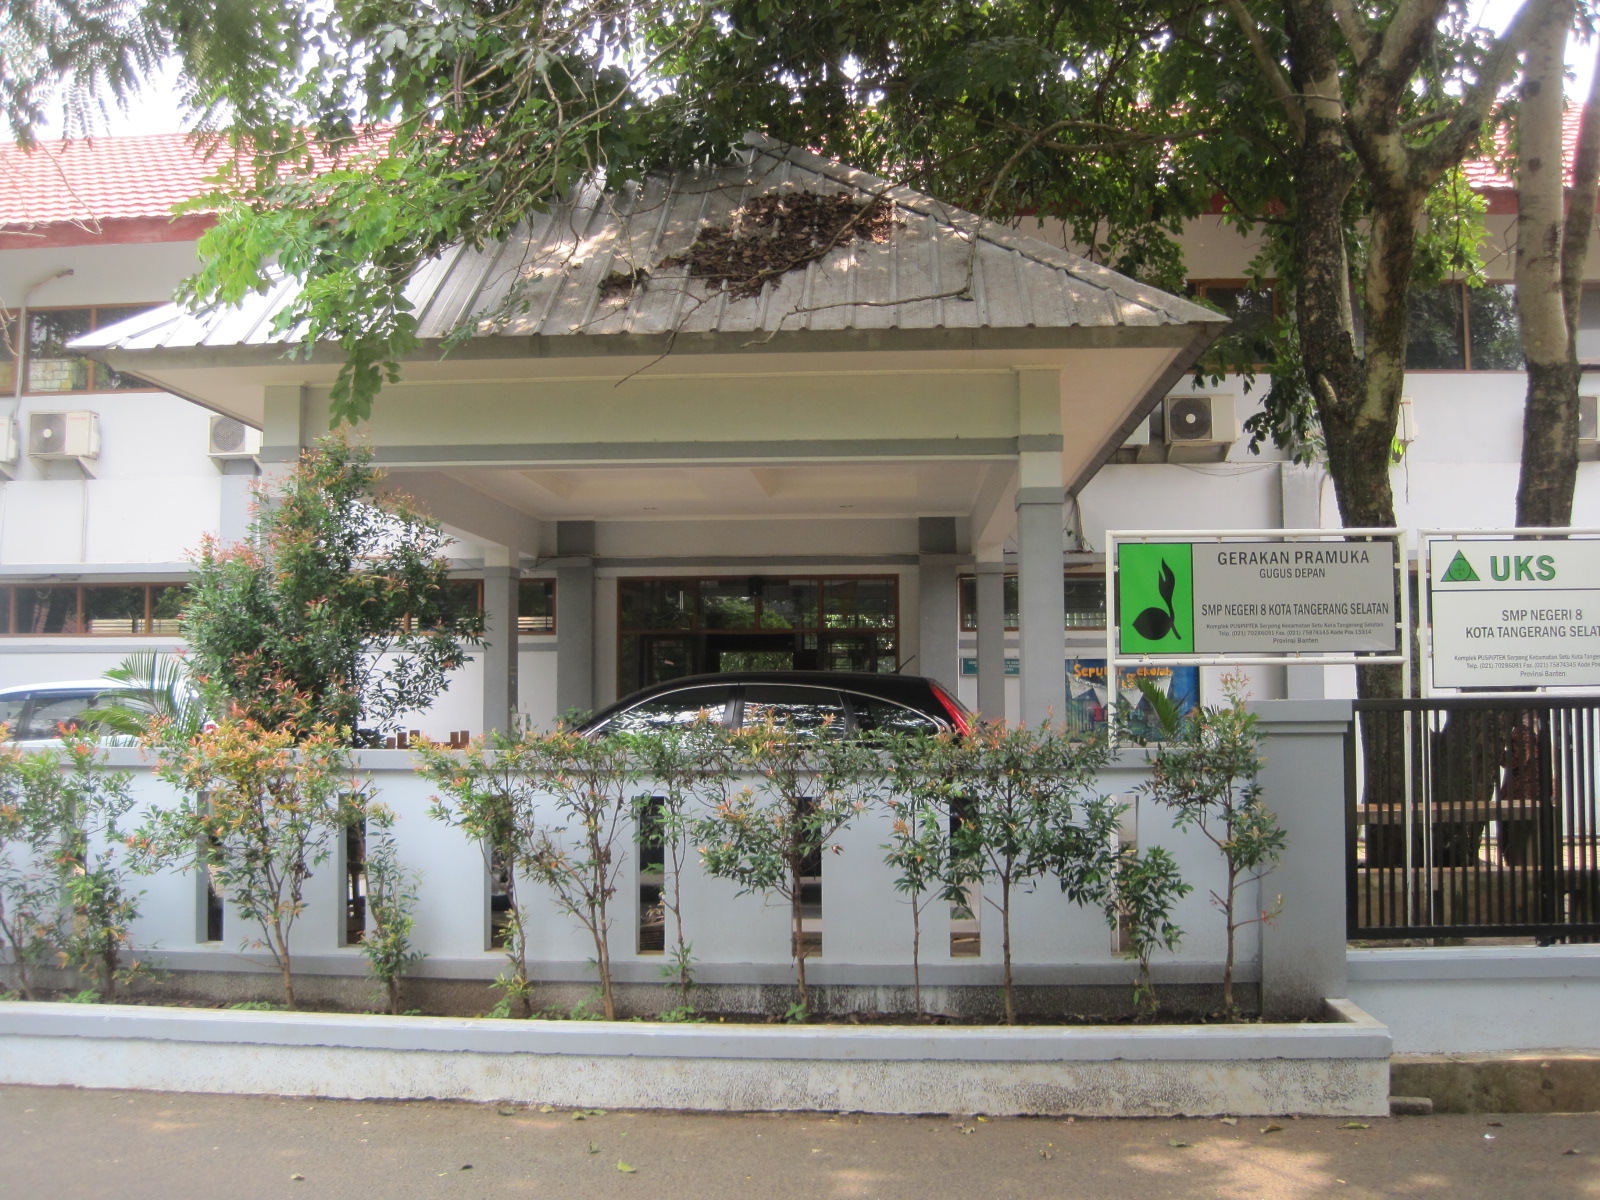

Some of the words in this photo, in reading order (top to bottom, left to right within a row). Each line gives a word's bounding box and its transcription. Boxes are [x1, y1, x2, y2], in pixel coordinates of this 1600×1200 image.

[1218, 551, 1290, 565] GERAKAN
[1294, 550, 1370, 564] PRAMUKA
[1259, 568, 1293, 579] GUGUS
[1295, 568, 1326, 578] DEPAN
[1490, 555, 1556, 582] UKS
[1201, 604, 1223, 616] SMP
[1225, 604, 1258, 616] NEGERI
[1260, 604, 1267, 616] 8
[1269, 604, 1292, 615] KOTA
[1293, 603, 1348, 615] TANGERANG
[1350, 602, 1389, 615] SELATAN
[1502, 609, 1527, 621] SMP
[1530, 609, 1572, 621] NEGERI
[1575, 608, 1583, 620] 8
[1465, 627, 1494, 639] KOTA
[1497, 626, 1566, 638] TANGERANG
